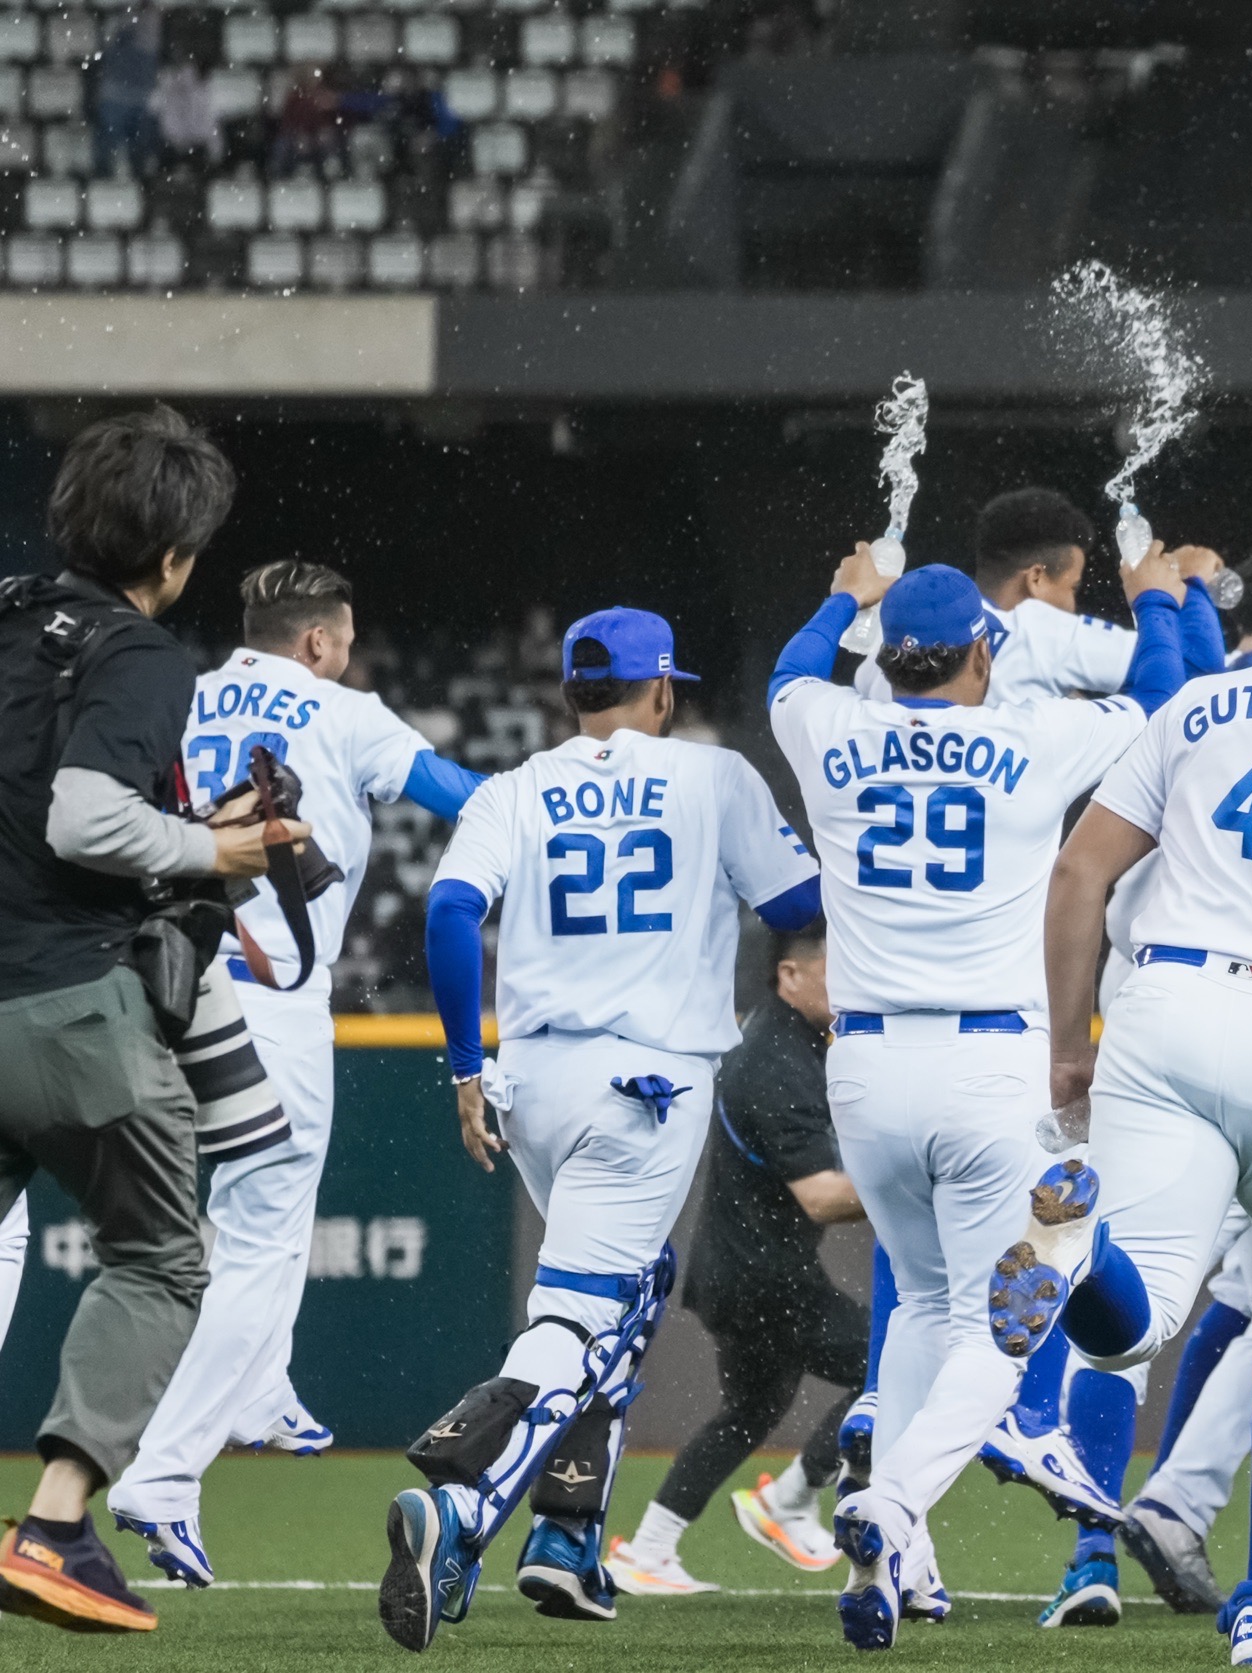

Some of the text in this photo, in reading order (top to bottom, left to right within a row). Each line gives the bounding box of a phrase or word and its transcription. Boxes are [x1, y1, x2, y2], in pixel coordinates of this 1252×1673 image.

[190, 682, 321, 730] LORES
[823, 730, 1029, 795] GLASGON
[541, 777, 668, 826] BONE
[856, 785, 986, 892] 29
[546, 828, 674, 936] 22
